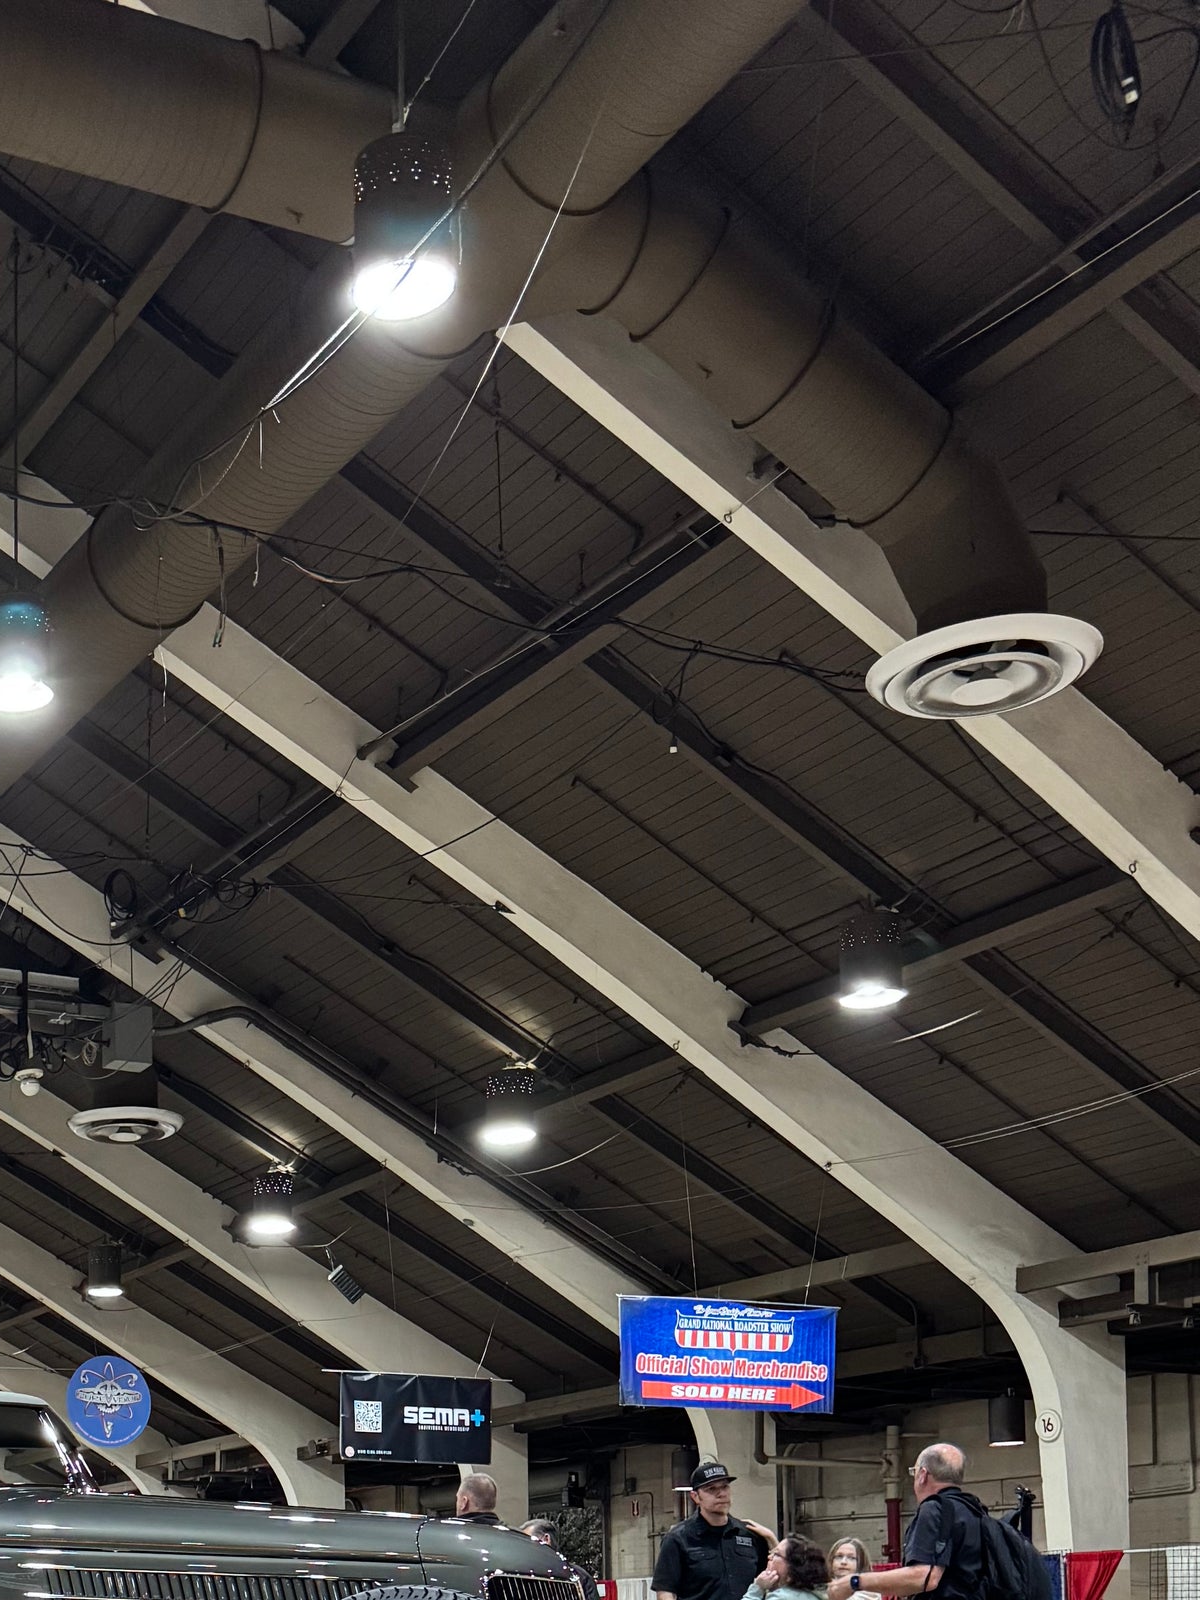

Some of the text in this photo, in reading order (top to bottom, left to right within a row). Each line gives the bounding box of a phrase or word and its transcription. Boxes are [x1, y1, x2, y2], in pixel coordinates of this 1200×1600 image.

[679, 1318, 792, 1334] GRAND NATIONAL ROADSTER SHOW
[636, 1354, 829, 1382] Official Show Merchandise
[671, 1385, 777, 1401] SOLD HERE
[1041, 1417, 1054, 1434] 16
